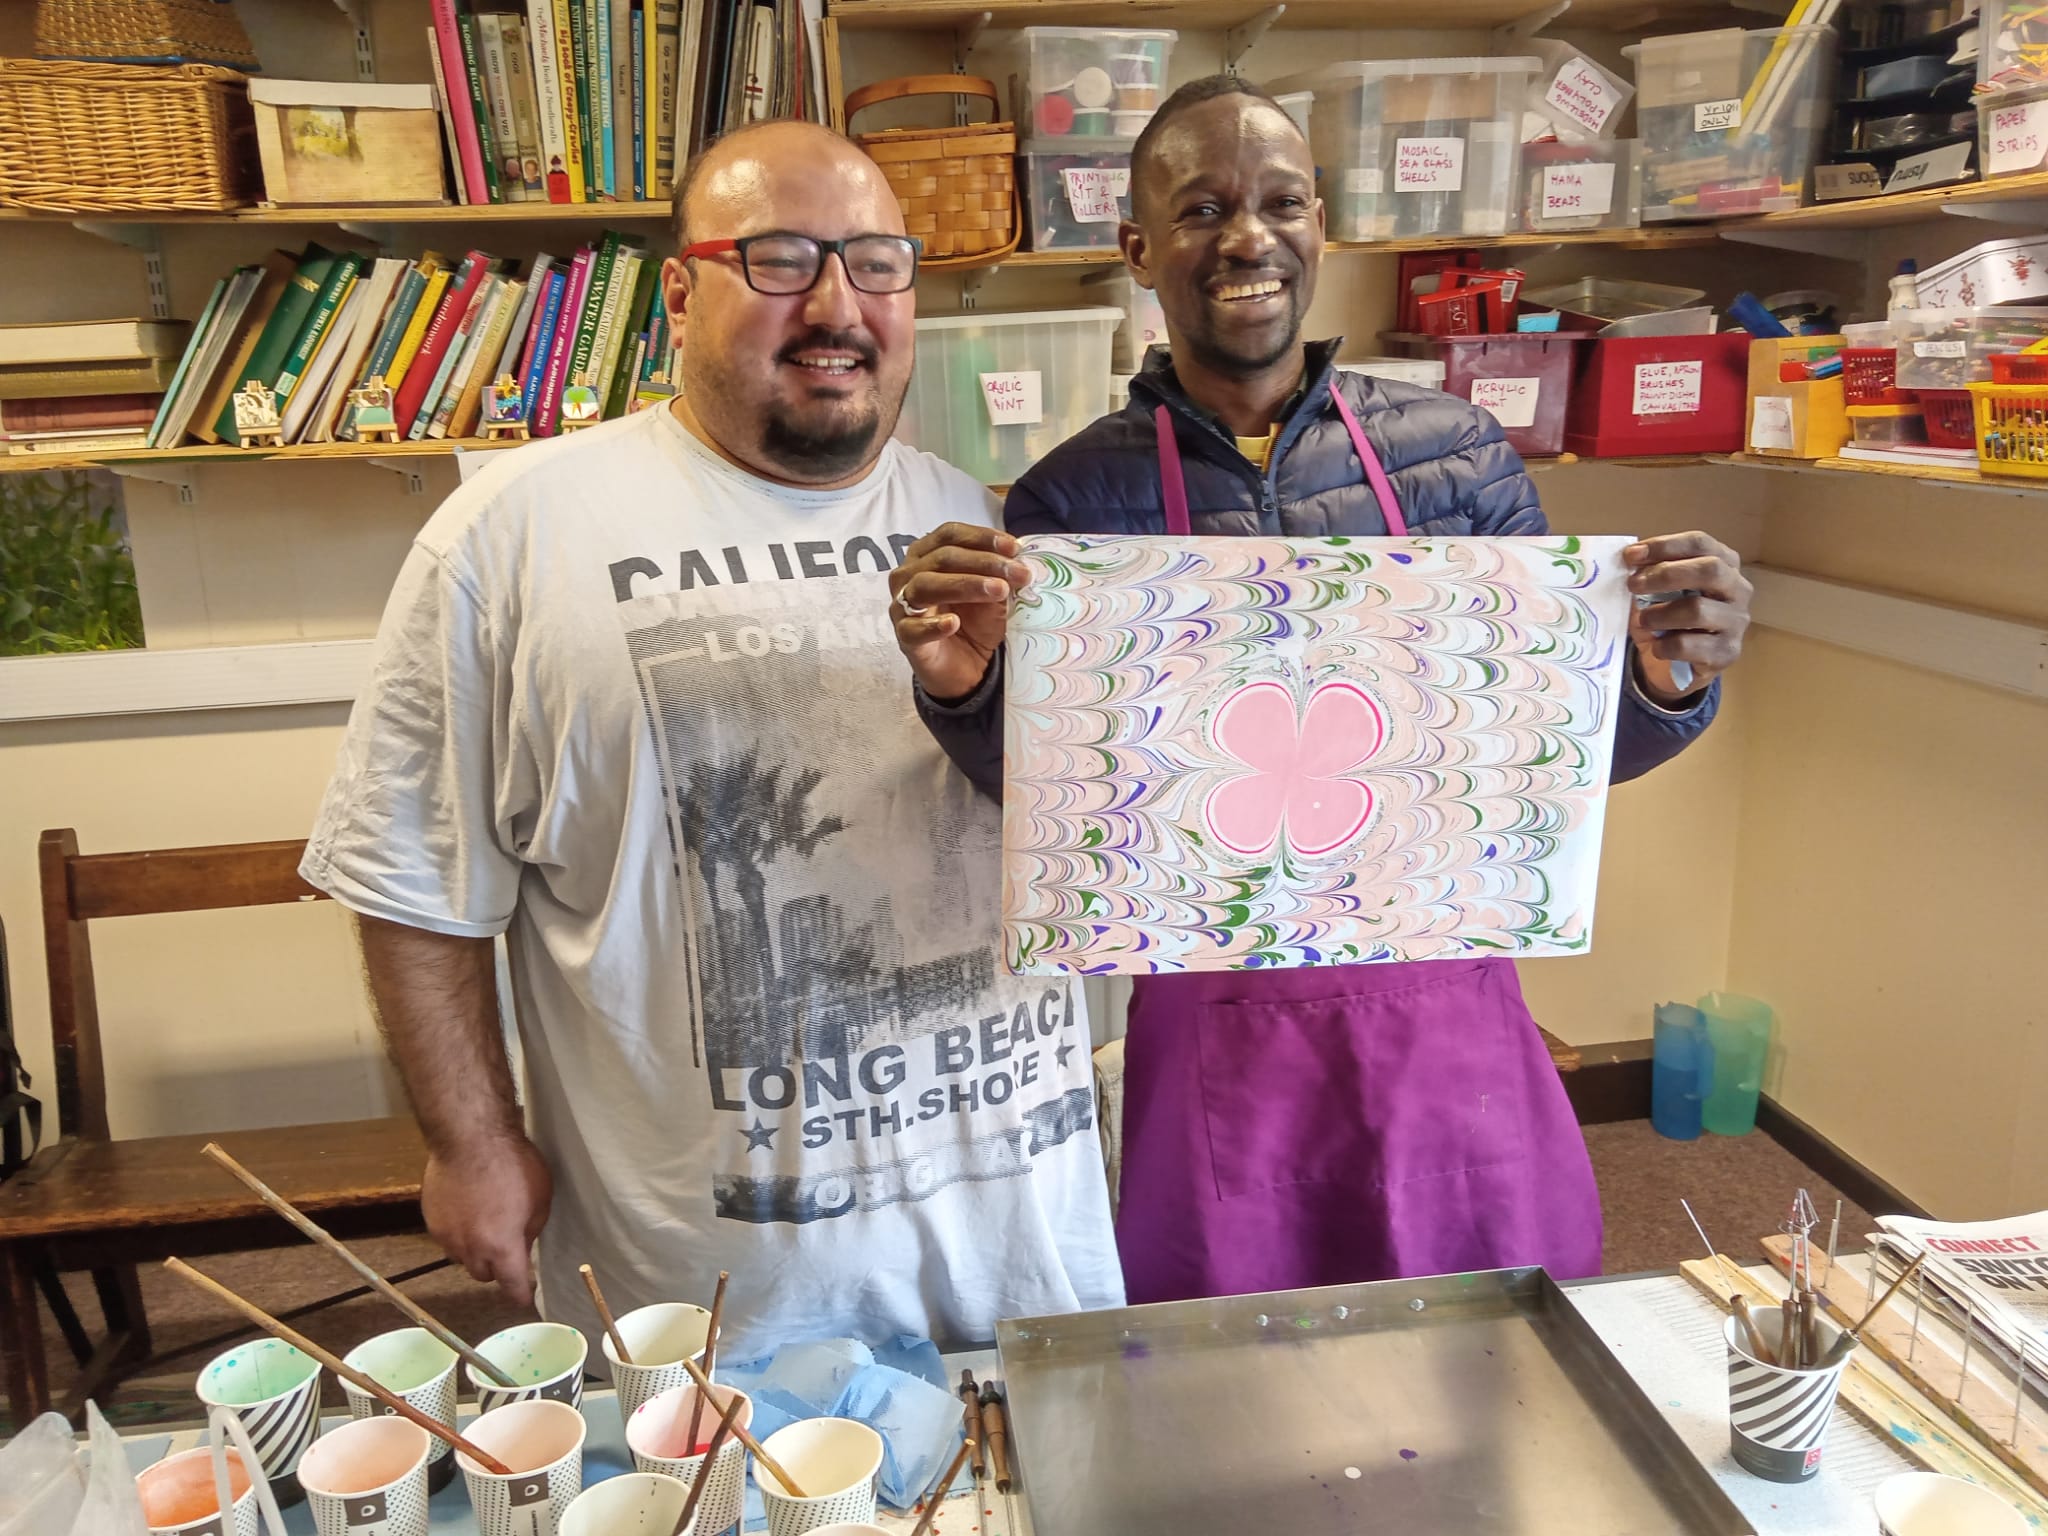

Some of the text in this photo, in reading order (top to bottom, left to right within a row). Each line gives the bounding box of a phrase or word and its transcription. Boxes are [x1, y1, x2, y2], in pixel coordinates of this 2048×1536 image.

[461, 23, 475, 64] BLOOMING
[537, 19, 550, 63] Michaels
[558, 29, 568, 43] Big
[570, 4, 585, 79] KNITTING WILDLIFE
[490, 49, 499, 73] GROW
[561, 46, 571, 70] Book
[599, 52, 607, 74] from
[542, 64, 550, 84] Book
[564, 72, 573, 84] of
[1574, 70, 1602, 95] CLAY
[544, 85, 552, 94] of
[663, 45, 671, 124] SINGER
[600, 78, 611, 127] NOTHING
[1555, 80, 1598, 112] POLYMER
[498, 98, 506, 117] OWN
[501, 119, 509, 135] VEG
[545, 95, 557, 144] Needlecrafts
[562, 86, 581, 164] Creepy-Crawlies
[1701, 115, 1730, 127] ONLY
[1996, 108, 2027, 132] PAPER
[1997, 134, 2039, 153] STRIPS
[1399, 159, 1453, 169] SEA GLASS
[1400, 170, 1437, 183] SHELLS
[1551, 174, 1582, 186] HAMA
[1072, 186, 1110, 200] KIT &
[1547, 195, 1581, 208] BEADS
[553, 280, 562, 295] THE
[549, 295, 558, 311] NEW
[582, 279, 605, 331] WATER
[591, 258, 626, 362] CONTAINER GARDENING
[418, 294, 456, 356] gardenwork
[535, 312, 554, 370] SUPERGARDENER
[538, 267, 581, 427] The Gardener's Year ALAN TITCHMARSH
[530, 375, 539, 392] ALAN
[1476, 382, 1526, 398] ACRYLIC
[1639, 378, 1684, 389] BRUSHES
[1640, 391, 1667, 400] PAINT
[705, 624, 801, 663] LOS
[707, 1043, 906, 1111] LONG
[1925, 1235, 2041, 1254] CONNECT
[1976, 1273, 2036, 1292] ON
